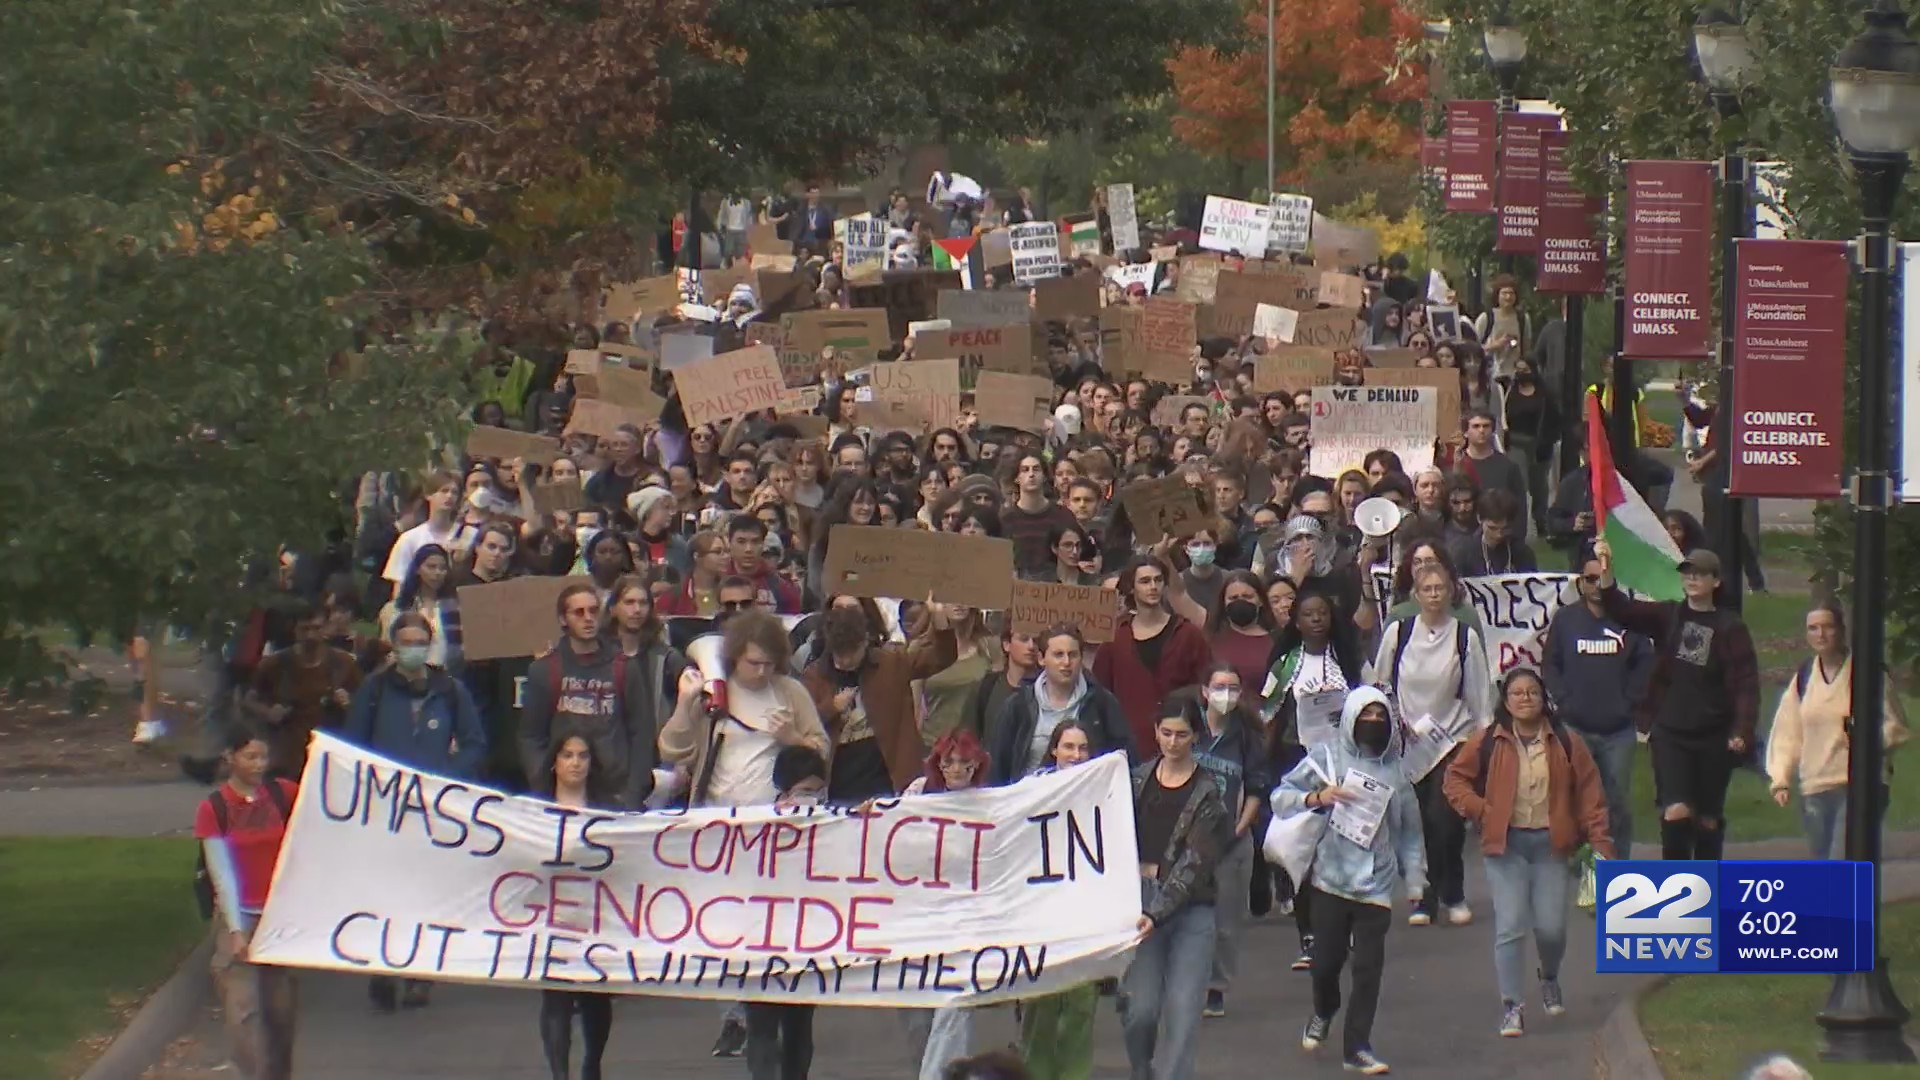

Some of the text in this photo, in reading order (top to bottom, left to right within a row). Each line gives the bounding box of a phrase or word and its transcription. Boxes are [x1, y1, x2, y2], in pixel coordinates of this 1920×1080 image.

[1220, 199, 1248, 218] END
[1503, 205, 1540, 215] CONNEC
[1275, 210, 1293, 221] Aid
[1503, 216, 1540, 226] CELEBRA
[848, 219, 885, 234] END ALL
[1503, 227, 1535, 237] UMASS.
[1545, 238, 1592, 249] CONNECT.
[1545, 251, 1600, 263] CELEBRATE.
[1544, 263, 1582, 274] UMASS.
[1748, 278, 1809, 289] UMassAmherst
[1633, 293, 1691, 305] CONNECT.
[1633, 308, 1701, 320] CELEBRATE.
[1747, 311, 1806, 321] Foundation
[1633, 323, 1679, 335] UMASS.
[1747, 337, 1809, 348] UMassAmherst
[733, 365, 776, 387] FREE
[688, 382, 785, 421] PALESTINE
[1332, 388, 1420, 403] WE DEMAND
[1744, 411, 1818, 427] CONNECT.
[1743, 431, 1831, 447] CELEBRATE.
[1742, 450, 1802, 466] UMASS.
[1577, 639, 1618, 655] PUMA
[320, 751, 1106, 892] UMASS IS COMPLICIT IN
[488, 870, 895, 955] GENOCIDE
[330, 911, 1048, 994] CUT TIES WITH RAYTHEON
